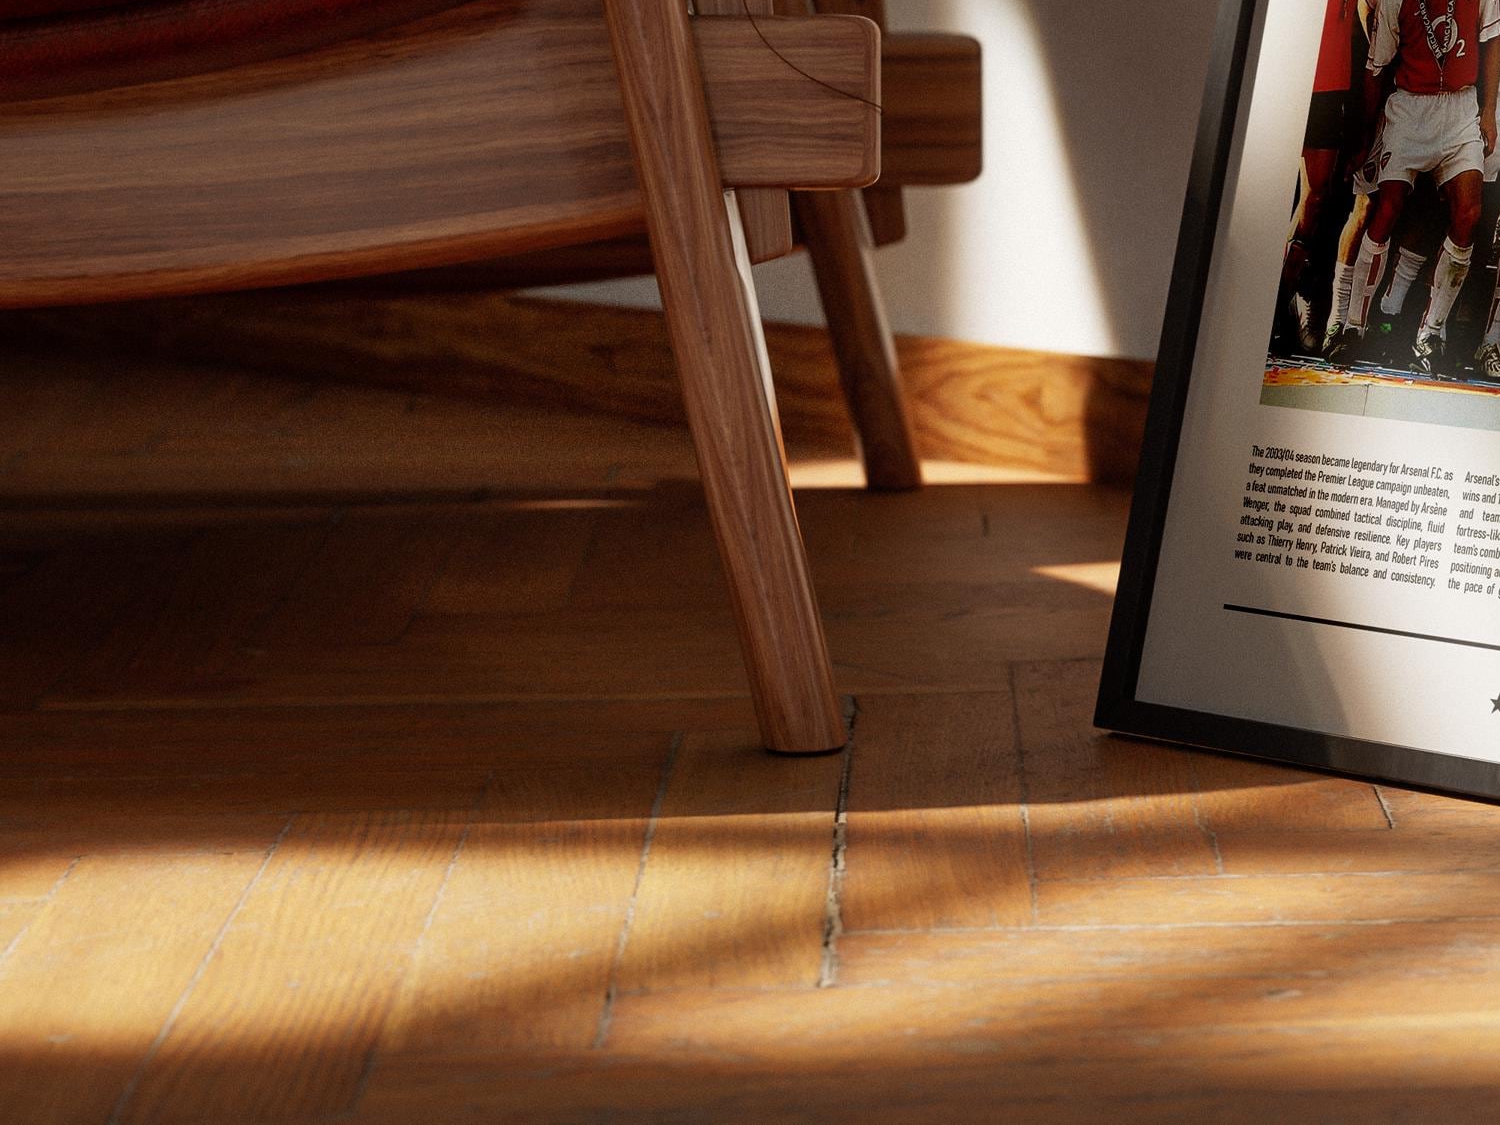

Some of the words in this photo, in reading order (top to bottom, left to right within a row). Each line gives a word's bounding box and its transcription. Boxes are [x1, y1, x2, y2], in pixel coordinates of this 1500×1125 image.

[1252, 445, 1265, 458] The
[1264, 447, 1295, 462] 2003/04
[1295, 453, 1321, 465] season
[1321, 454, 1351, 469] became
[1351, 457, 1389, 476] legendary
[1389, 462, 1401, 475] for
[1400, 464, 1430, 478] Arsenal
[1444, 472, 1454, 481] as
[1464, 471, 1500, 487] Arsenal's
[1462, 490, 1481, 502] wins
[1481, 493, 1497, 504] and
[1459, 509, 1474, 520] and
[1454, 543, 1479, 557] team's
[1234, 550, 1253, 561] were
[1255, 552, 1283, 565] central
[1285, 554, 1294, 567] to
[1296, 556, 1310, 569] the
[1312, 558, 1337, 573] team's
[1339, 562, 1370, 578] balance
[1372, 568, 1388, 580] and
[1390, 572, 1436, 589] consistency.
[1450, 562, 1493, 580] positioning
[1448, 578, 1461, 590] the
[1464, 582, 1483, 594] pace
[1486, 584, 1496, 595] of
